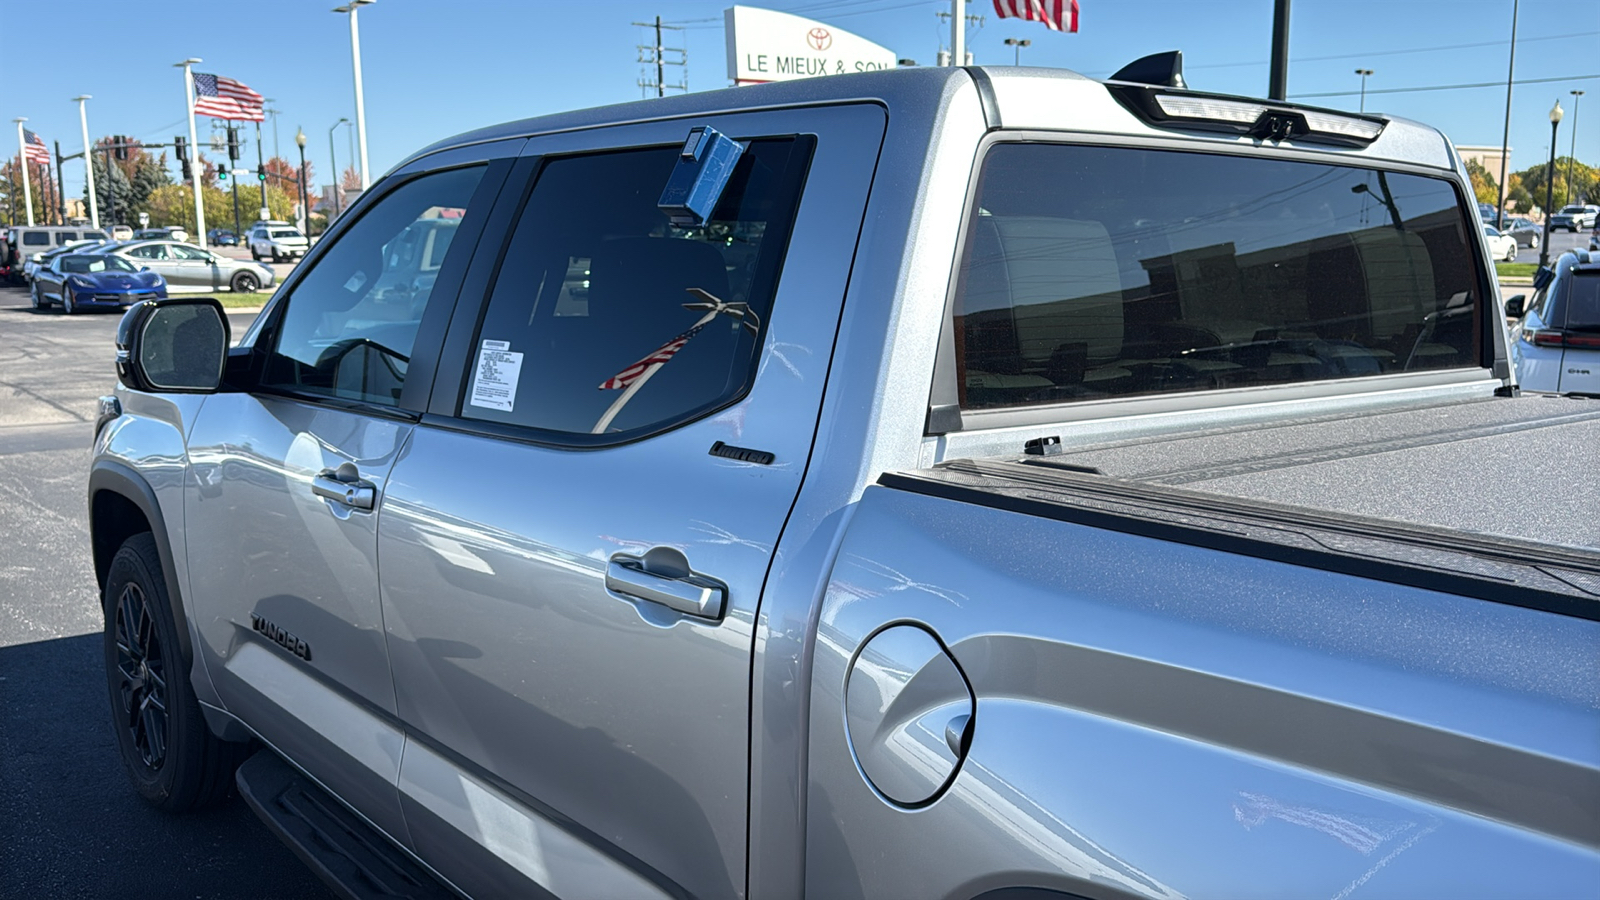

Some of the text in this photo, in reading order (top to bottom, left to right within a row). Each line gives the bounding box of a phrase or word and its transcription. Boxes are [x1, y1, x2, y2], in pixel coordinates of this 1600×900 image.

[747, 54, 768, 73] LE
[776, 56, 827, 76] MIEUX
[836, 59, 846, 75] &
[251, 611, 312, 661] TUNDRA
